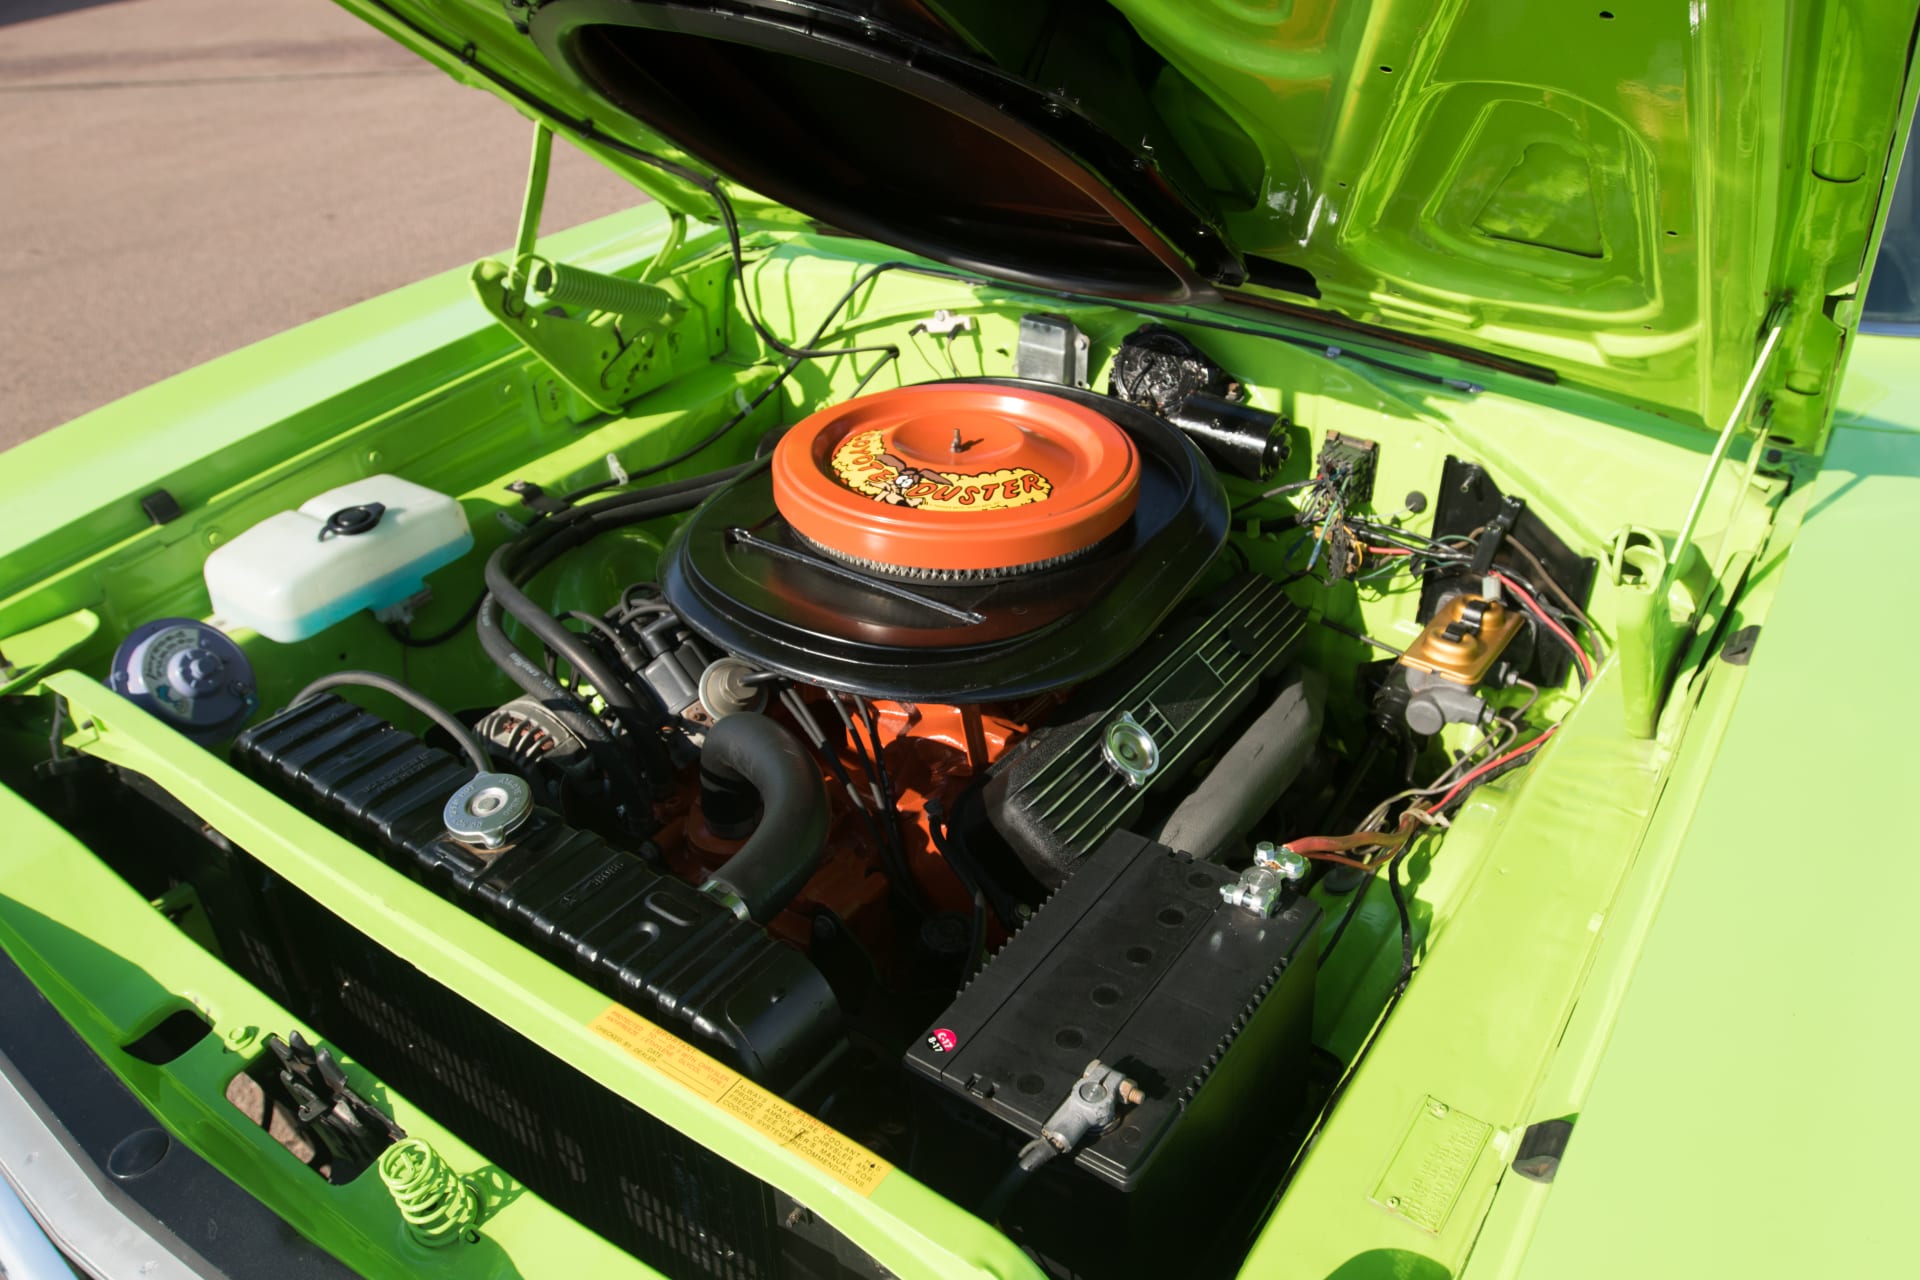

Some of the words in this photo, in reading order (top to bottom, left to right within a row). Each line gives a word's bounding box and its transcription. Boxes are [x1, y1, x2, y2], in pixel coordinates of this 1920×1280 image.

[851, 432, 895, 482] COYOTE
[906, 473, 1044, 505] DUSTER
[631, 1046, 659, 1064] DEALER
[646, 1046, 663, 1058] DATE
[937, 1032, 953, 1048] C-17
[721, 1098, 754, 1120] COOLING
[790, 1139, 865, 1187] RECOMMENDATIONS
[727, 1093, 756, 1112] FREEZE
[761, 1113, 778, 1125] SEE
[819, 1148, 851, 1169] MANUAL
[854, 1169, 873, 1183] FOR
[733, 1088, 763, 1109] PROPER
[764, 1107, 796, 1128] AMOUNT
[812, 1135, 853, 1162] CHRYSLER
[738, 1083, 767, 1103] ALWAYS
[771, 1103, 793, 1118] MAKE
[796, 1117, 818, 1133] SURE
[822, 1132, 860, 1158] COOLANT
[864, 1158, 882, 1172] HS
